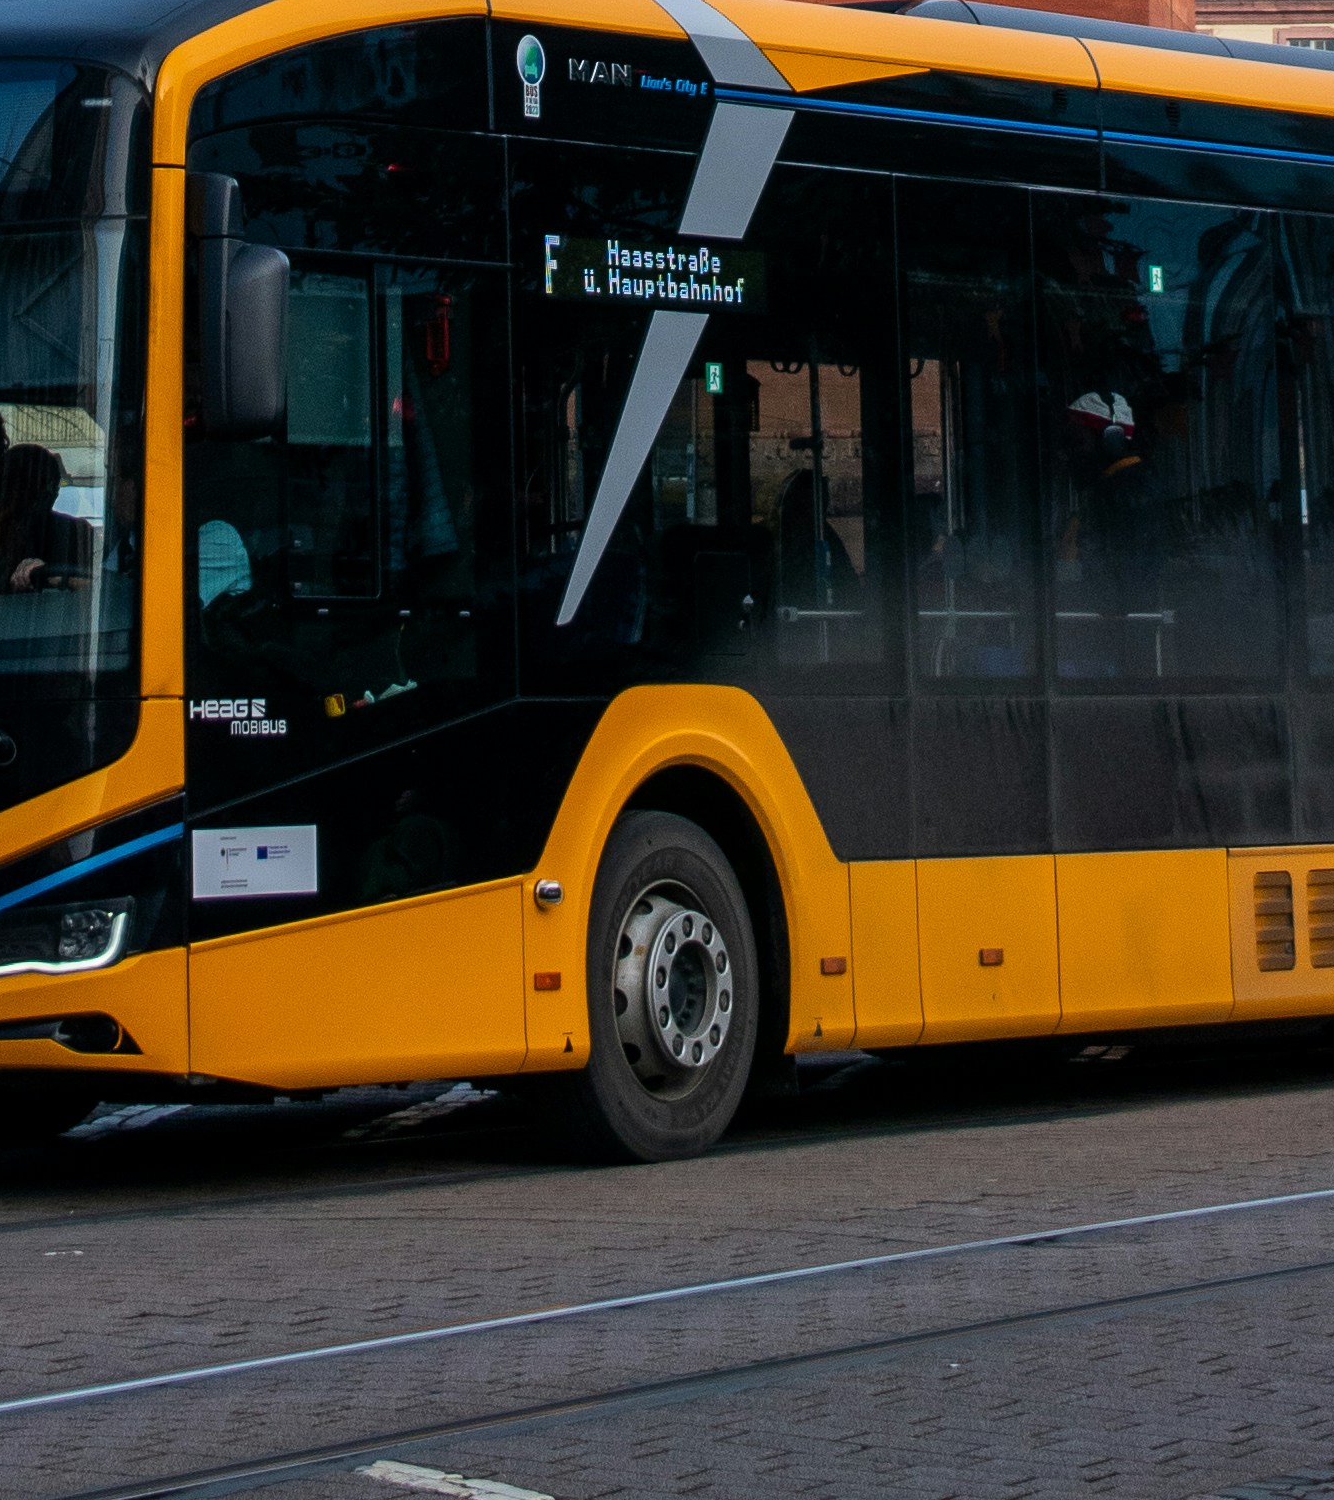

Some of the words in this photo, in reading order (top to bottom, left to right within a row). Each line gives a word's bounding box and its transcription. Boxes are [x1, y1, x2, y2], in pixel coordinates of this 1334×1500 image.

[568, 58, 632, 87] MAN
[640, 75, 672, 90] Lion's
[675, 79, 697, 96] City
[700, 82, 708, 95] E
[545, 234, 560, 294] F
[607, 239, 721, 274] Haasstraße
[583, 268, 601, 293] ü.
[608, 268, 744, 303] Hauptbahnhof
